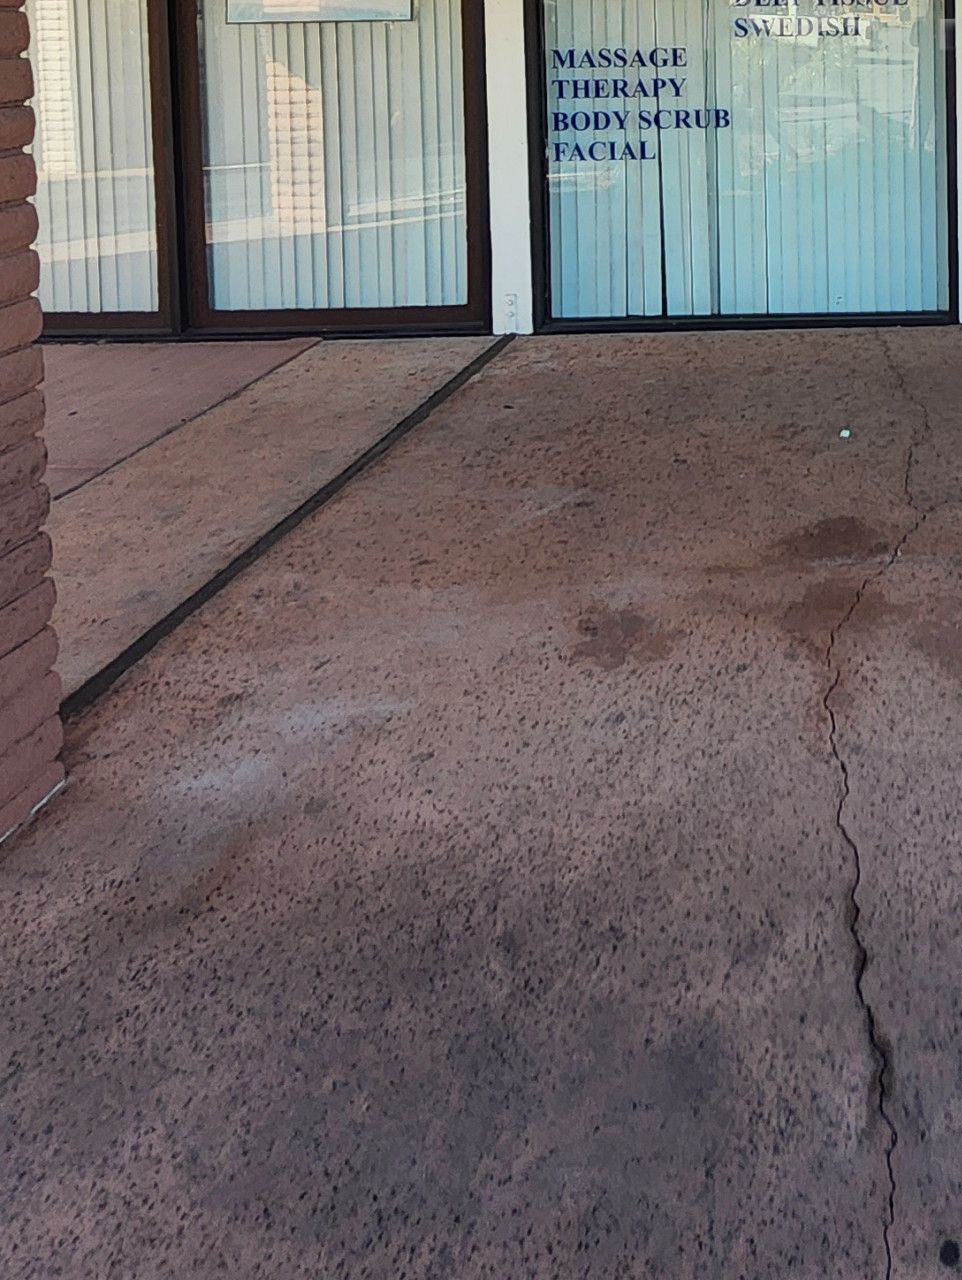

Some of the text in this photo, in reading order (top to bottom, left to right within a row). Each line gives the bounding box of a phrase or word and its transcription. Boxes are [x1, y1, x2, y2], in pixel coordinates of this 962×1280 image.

[734, 16, 861, 38] SWEDISH
[551, 47, 688, 69] MASSAGE
[552, 78, 687, 99] THERAPY
[552, 109, 731, 132] BODY SCRUB
[553, 141, 657, 162] FACIAL
